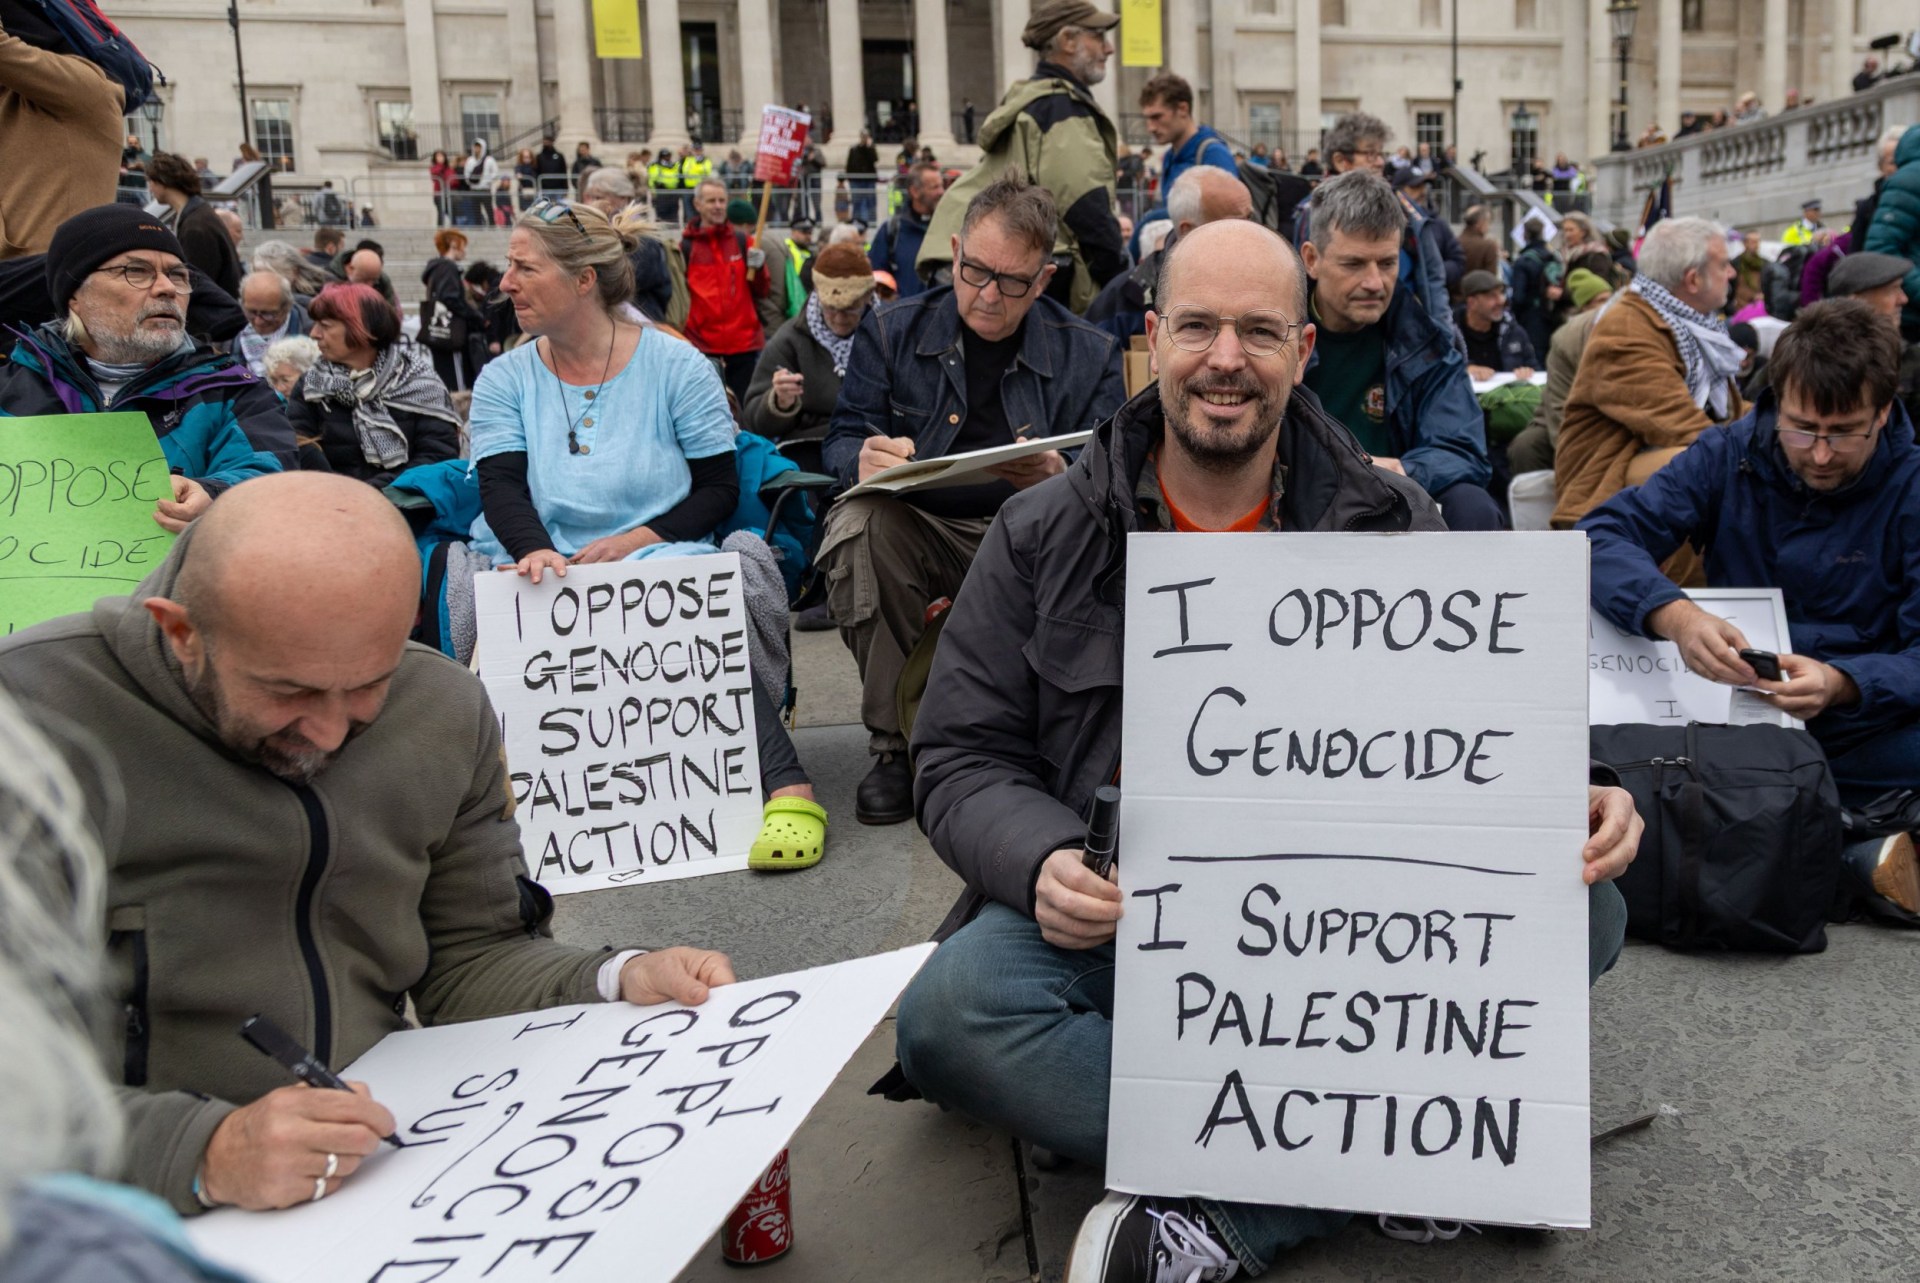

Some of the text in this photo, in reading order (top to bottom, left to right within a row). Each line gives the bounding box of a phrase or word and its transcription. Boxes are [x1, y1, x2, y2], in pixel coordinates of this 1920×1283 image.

[515, 571, 735, 642] I OPPOSE
[1147, 577, 1528, 659] I OPPOSE
[523, 629, 746, 695] GENOCIDE
[538, 687, 751, 756] SUPPORT
[1186, 686, 1514, 785] GENOCIDE
[1655, 700, 1682, 718] I
[510, 746, 752, 822] PALESTINE
[536, 808, 718, 882] ACTION
[1131, 883, 1516, 967] I SUPPORT
[512, 1010, 586, 1040] I
[1175, 972, 1540, 1059] PALESTINE
[481, 990, 801, 1277] OPPOSE
[706, 1096, 782, 1127] I
[1195, 1069, 1521, 1166] ACTION
